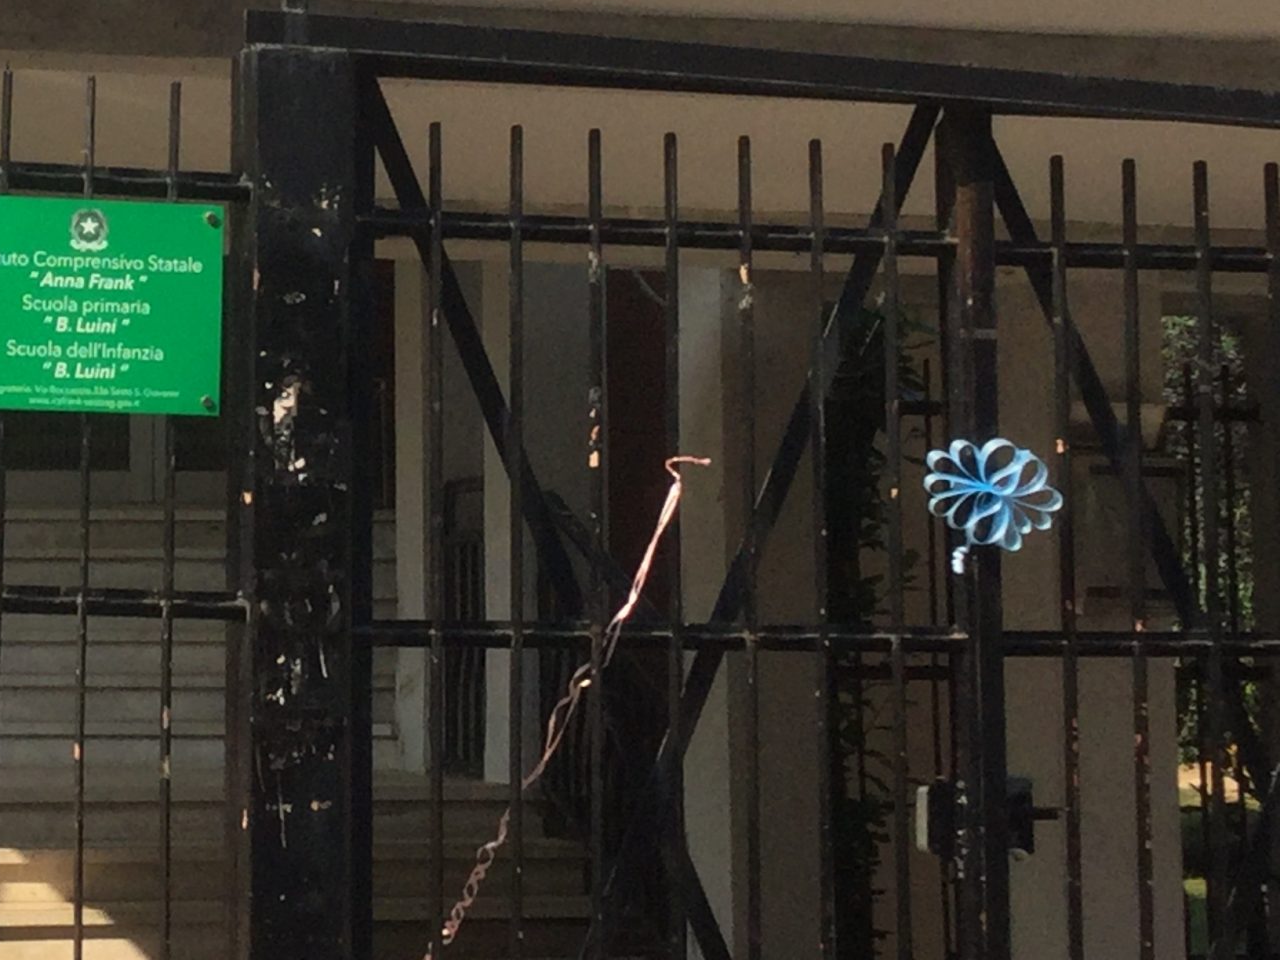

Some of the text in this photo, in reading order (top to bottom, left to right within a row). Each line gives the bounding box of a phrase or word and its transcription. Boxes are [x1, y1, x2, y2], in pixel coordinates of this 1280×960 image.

[33, 250, 144, 272] Comprensivo
[148, 255, 203, 273] Statale
[22, 294, 150, 317] Scuola primaria
[6, 339, 164, 361] Scuola dell'Infanzia
